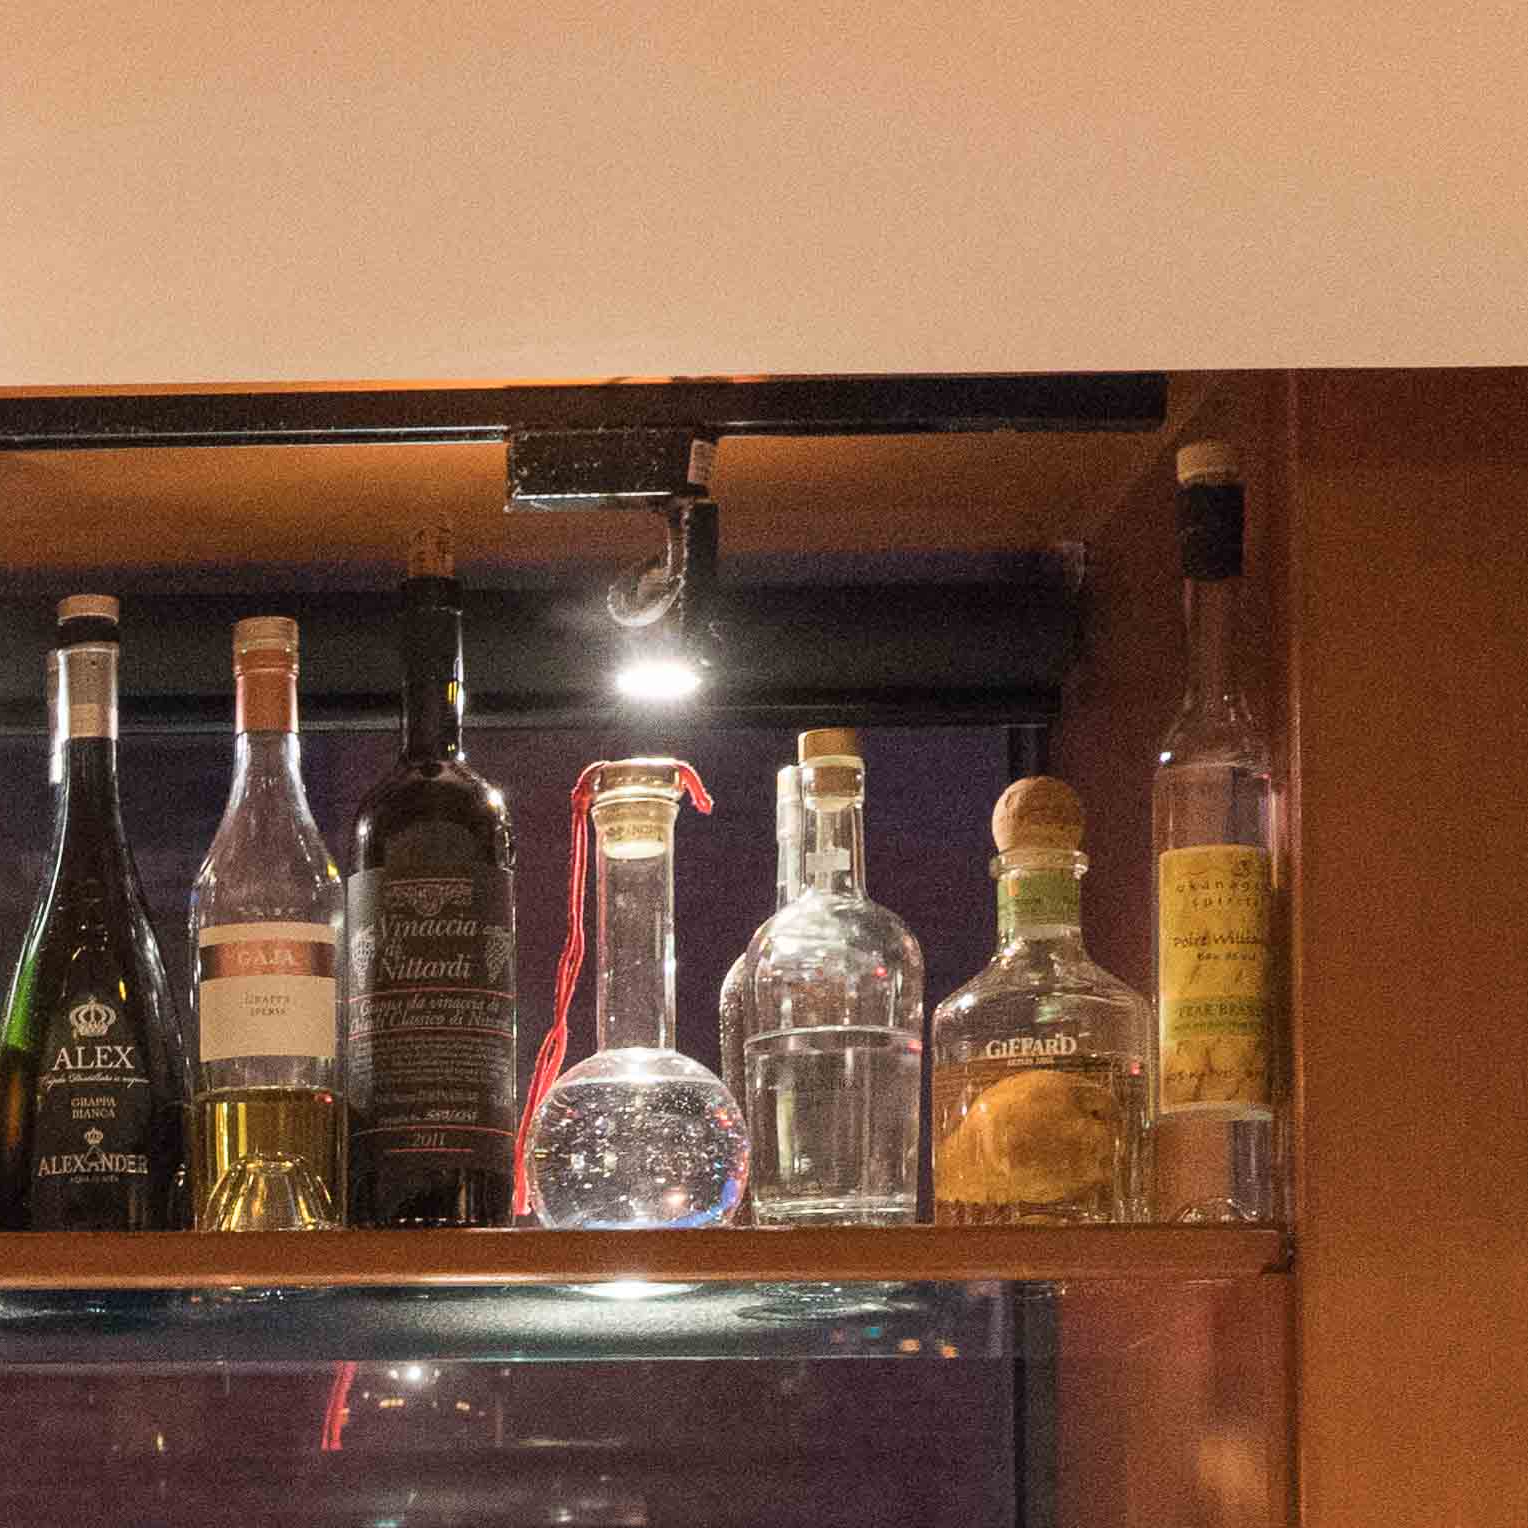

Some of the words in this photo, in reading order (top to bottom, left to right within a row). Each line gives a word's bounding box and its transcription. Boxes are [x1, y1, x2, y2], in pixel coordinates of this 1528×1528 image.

[237, 947, 296, 967] GAJA
[382, 954, 473, 981] Nittardi
[51, 1044, 136, 1072] ALEX
[986, 1034, 1079, 1060] GIFFARD
[37, 1147, 149, 1177] ALEXANDER
